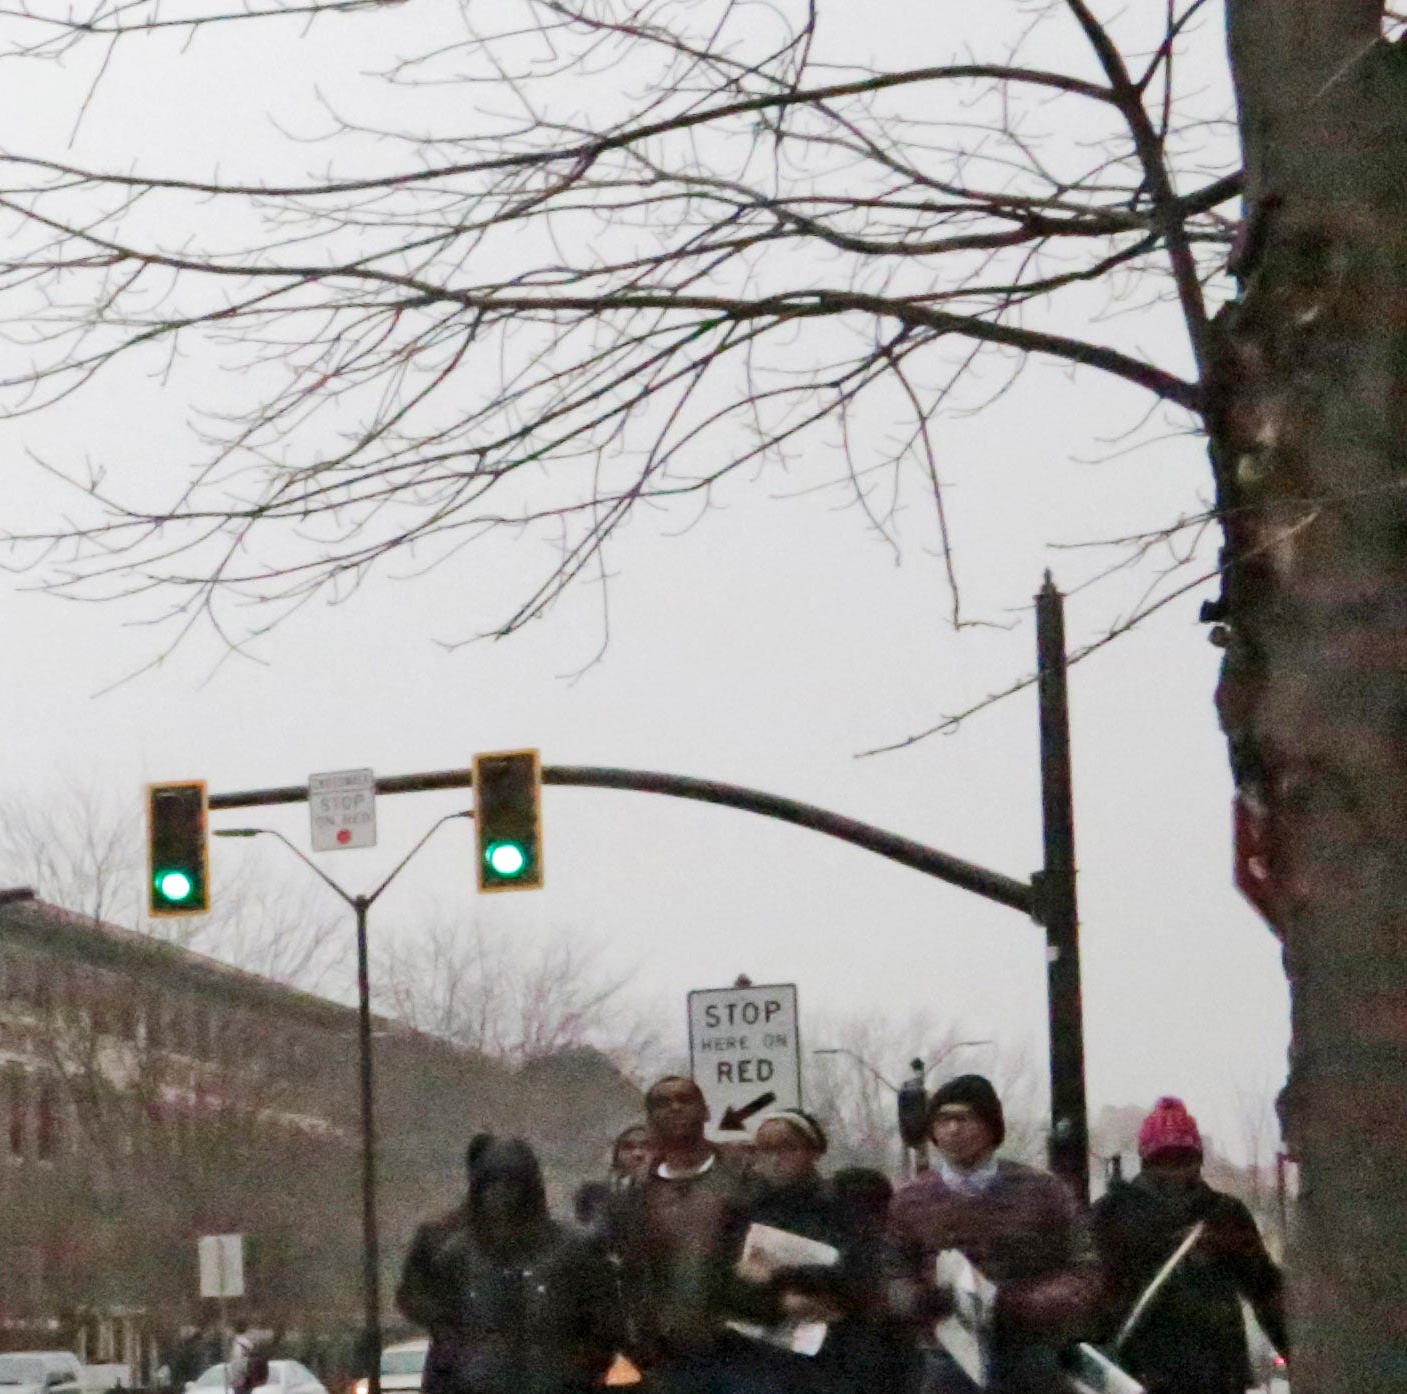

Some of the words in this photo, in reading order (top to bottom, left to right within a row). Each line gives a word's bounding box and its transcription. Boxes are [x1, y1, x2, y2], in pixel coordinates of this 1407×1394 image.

[705, 1000, 781, 1028] STOP
[701, 1035, 750, 1052] HERE
[762, 1033, 788, 1049] ON
[717, 1058, 775, 1083] RED
